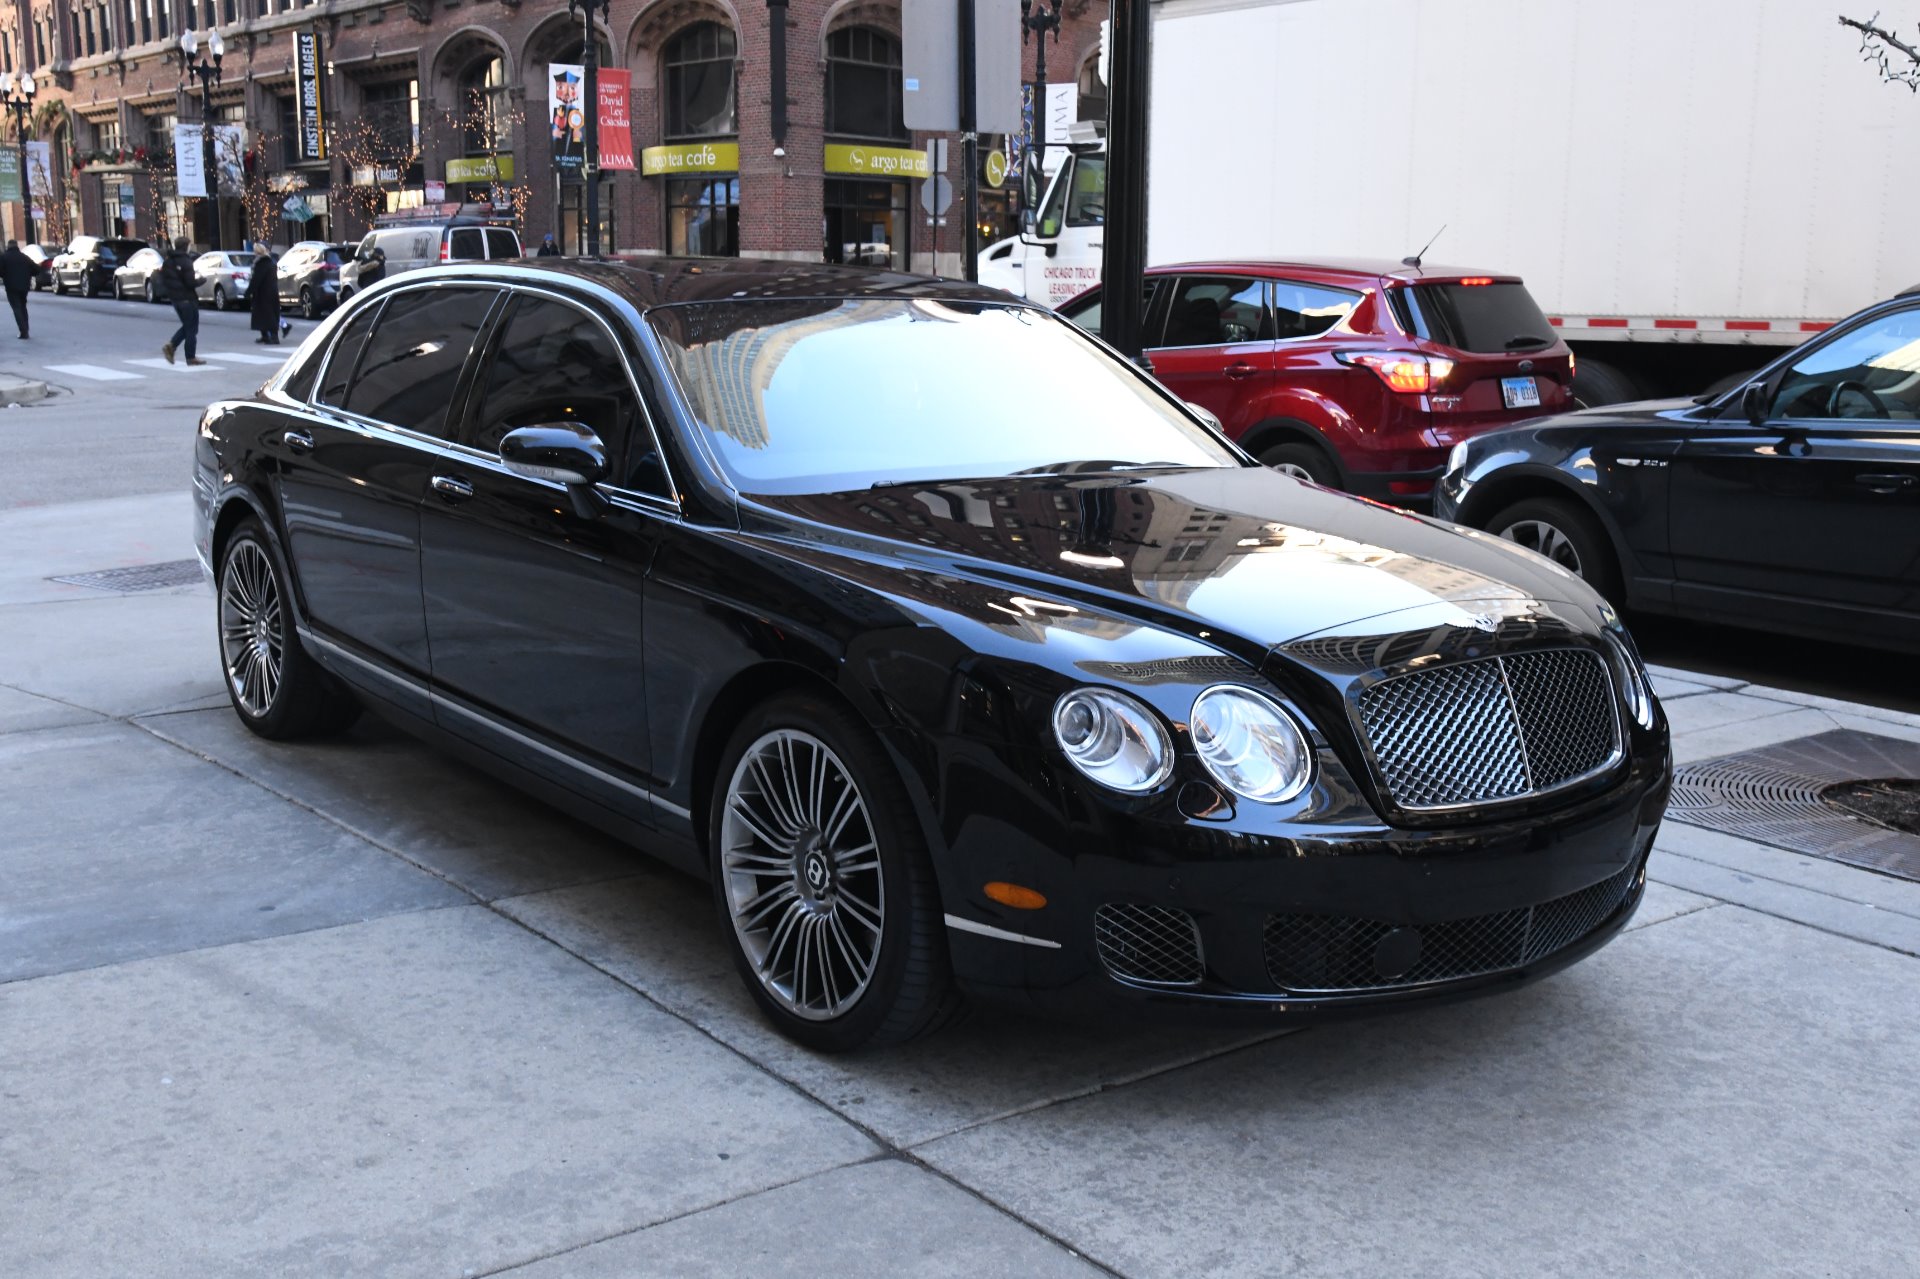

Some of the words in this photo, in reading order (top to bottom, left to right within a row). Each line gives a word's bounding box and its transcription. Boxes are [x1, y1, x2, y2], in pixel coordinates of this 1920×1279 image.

[302, 35, 315, 76] BAGELS
[600, 95, 623, 106] David
[610, 105, 624, 116] Lee
[600, 115, 630, 127] Csicsko
[306, 110, 319, 157] EINSTEIN
[600, 153, 634, 166] LUMA
[669, 152, 683, 167] tea
[686, 144, 716, 166] café
[871, 155, 897, 173] argo
[900, 155, 913, 170] tea
[915, 154, 928, 172] caf
[1044, 267, 1072, 278] CHICAGO
[1075, 267, 1096, 278] TRUCK
[1049, 283, 1076, 294] LEASING
